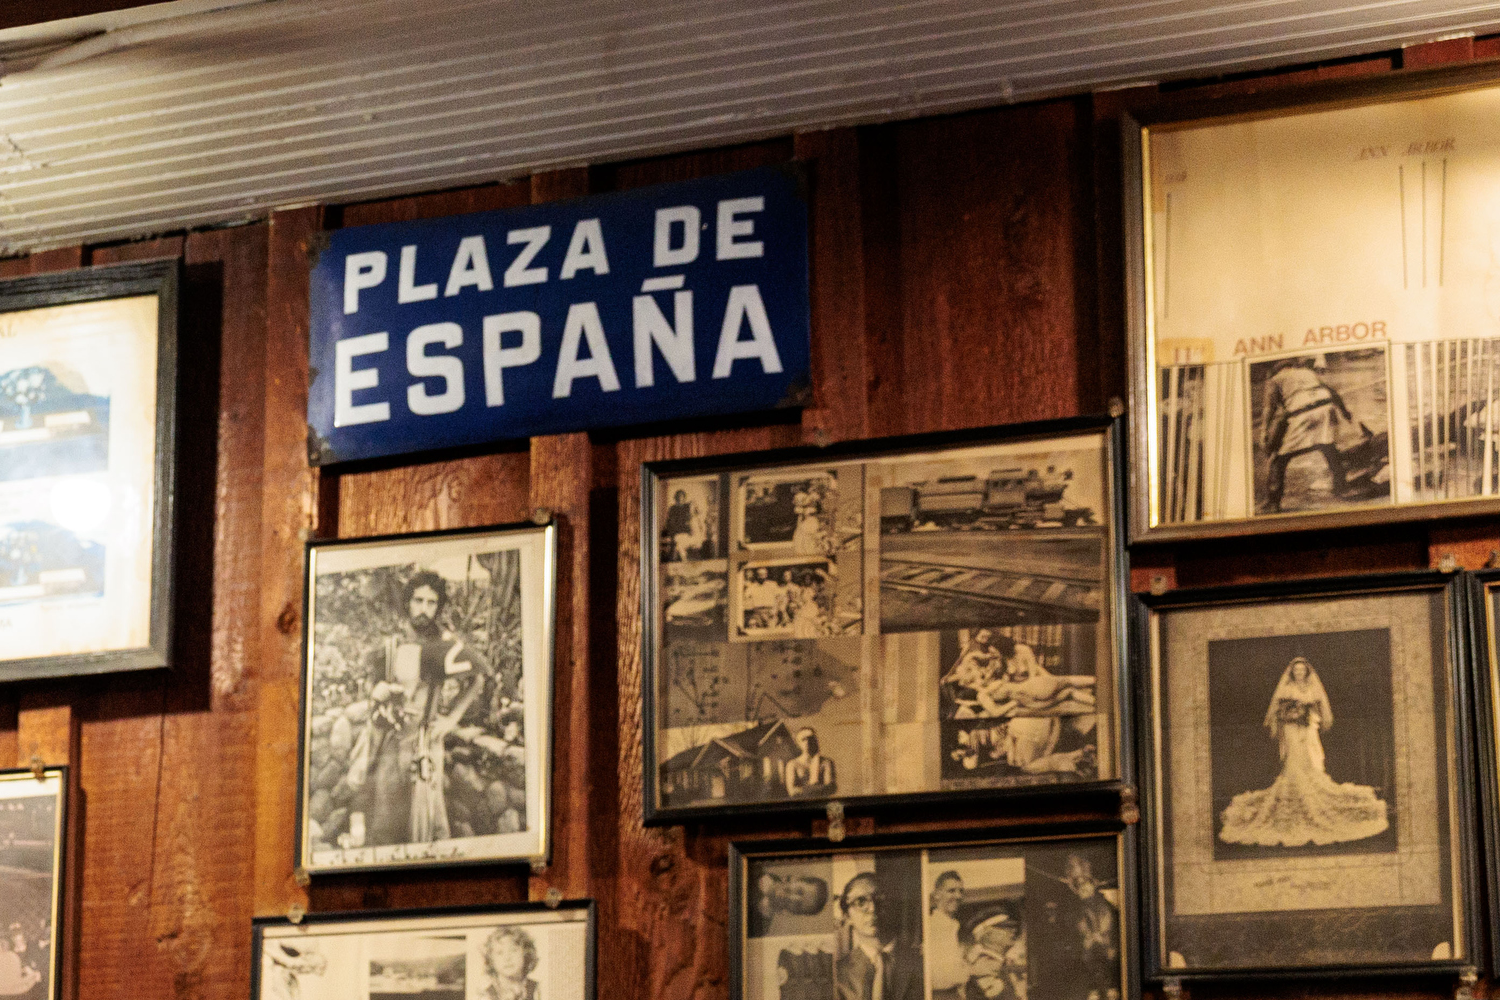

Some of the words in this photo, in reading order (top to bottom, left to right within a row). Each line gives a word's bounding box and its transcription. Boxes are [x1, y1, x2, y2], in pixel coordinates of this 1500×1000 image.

[344, 218, 610, 315] PLAZA
[653, 196, 765, 268] DE
[333, 274, 784, 428] ESPAÑA
[1233, 333, 1284, 357] ANN
[1303, 320, 1388, 346] ARBOR
